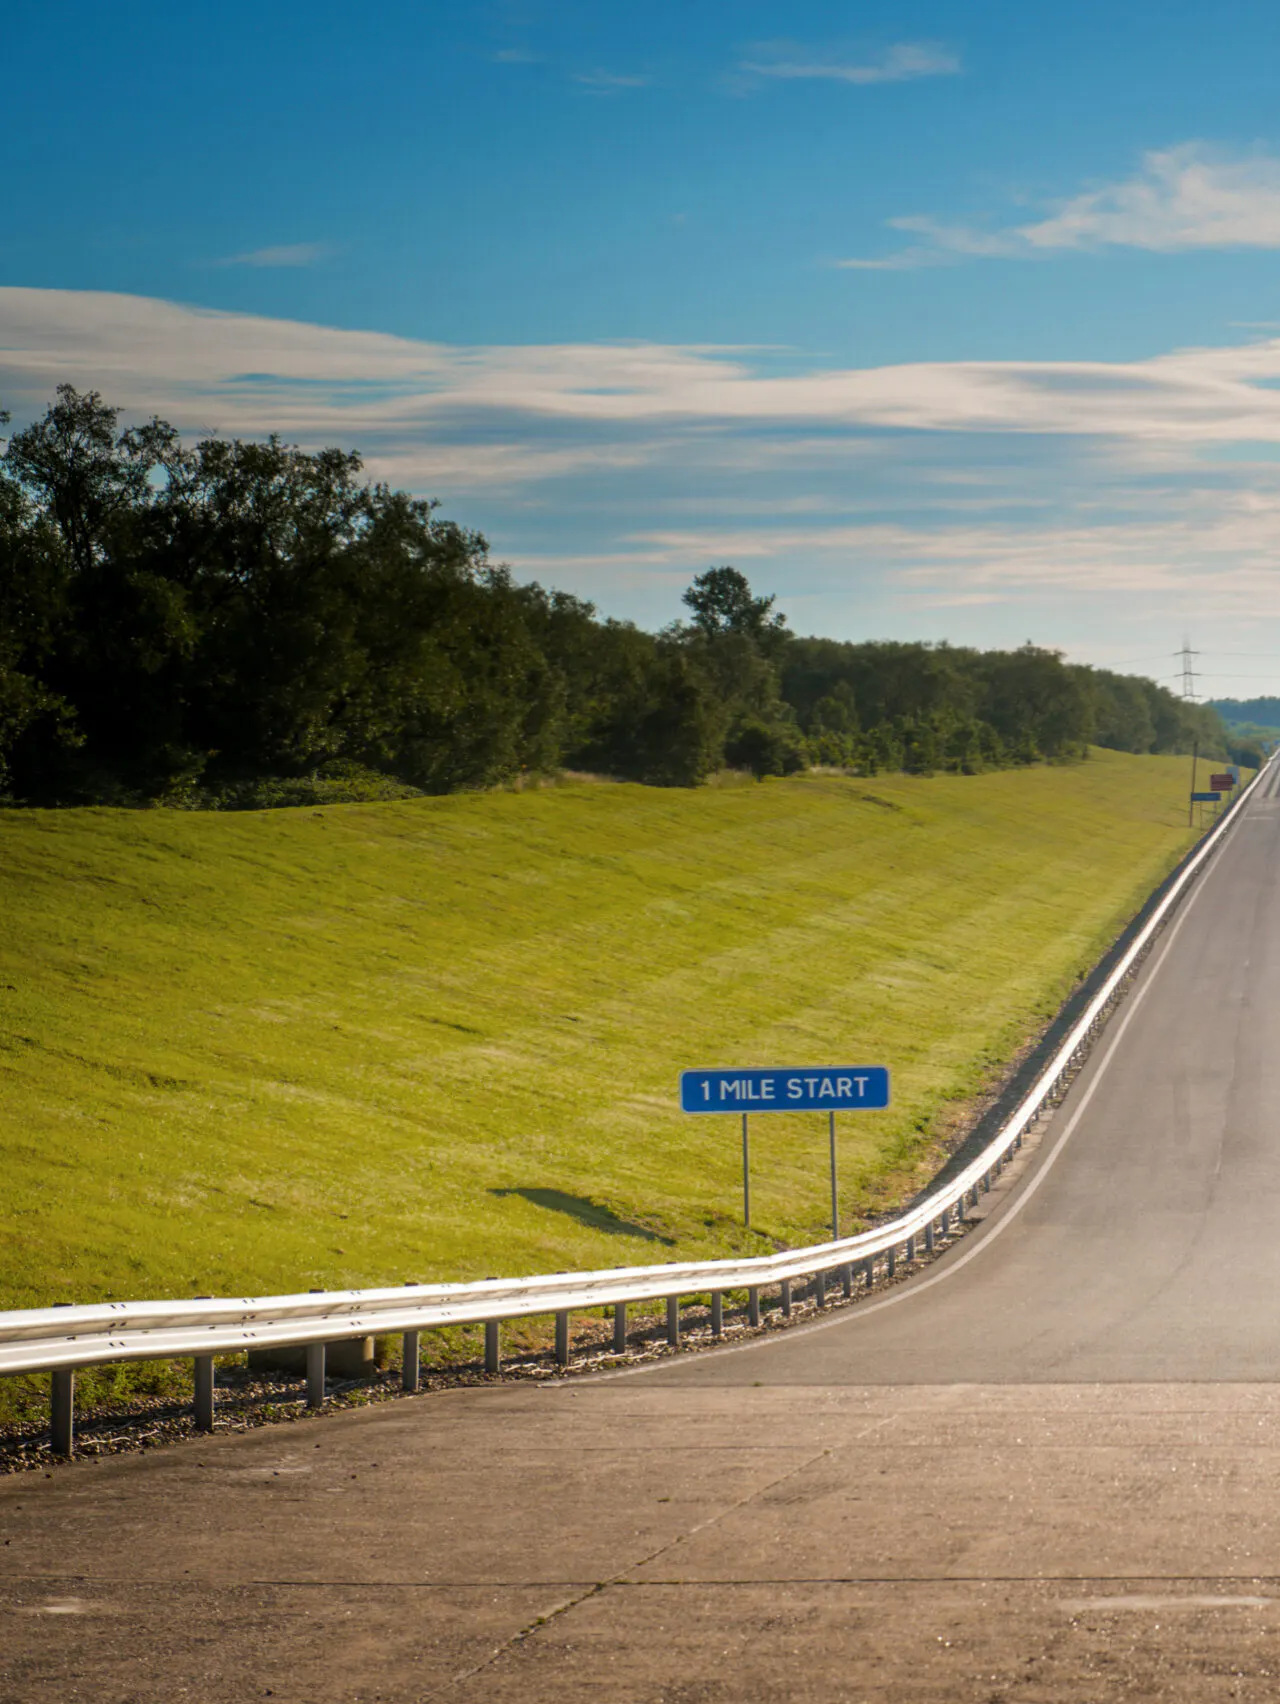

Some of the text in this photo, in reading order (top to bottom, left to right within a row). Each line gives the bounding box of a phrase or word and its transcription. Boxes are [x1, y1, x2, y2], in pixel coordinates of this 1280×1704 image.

[700, 1076, 869, 1100] 1 MILE START
